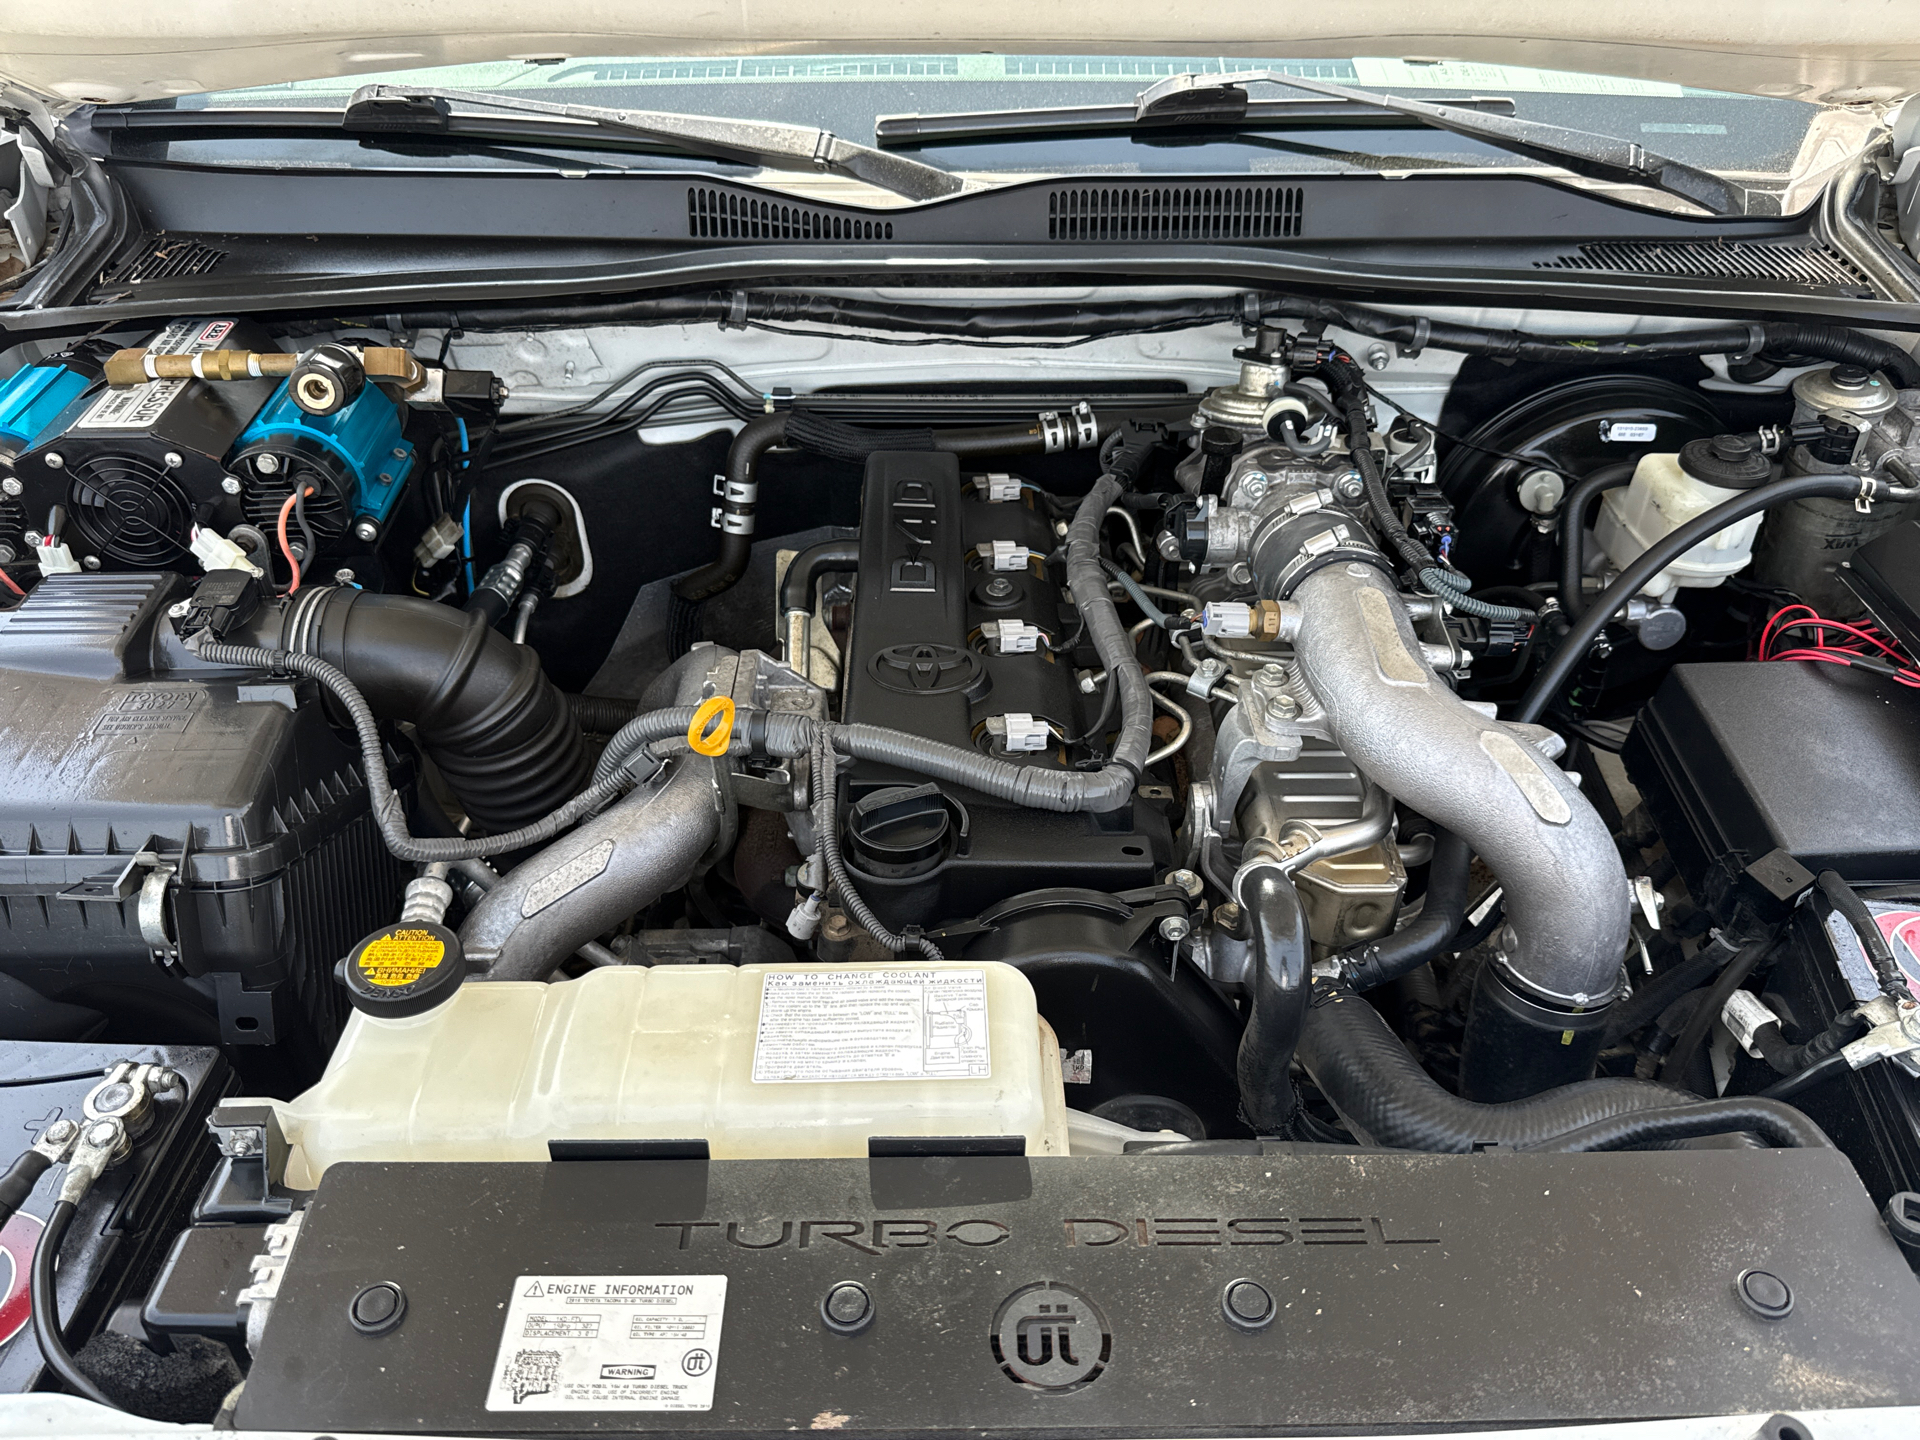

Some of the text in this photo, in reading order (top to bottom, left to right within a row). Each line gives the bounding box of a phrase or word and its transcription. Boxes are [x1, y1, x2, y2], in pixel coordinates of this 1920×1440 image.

[129, 379, 181, 422] PRESSOR
[129, 692, 193, 701] TOYOTA
[360, 984, 415, 998] DENSO
[971, 1066, 986, 1074] LH
[654, 1216, 1441, 1257] TURBO DIESEL
[547, 1284, 694, 1295] ENGINE INFORMATION
[608, 1368, 649, 1376] WARNING
